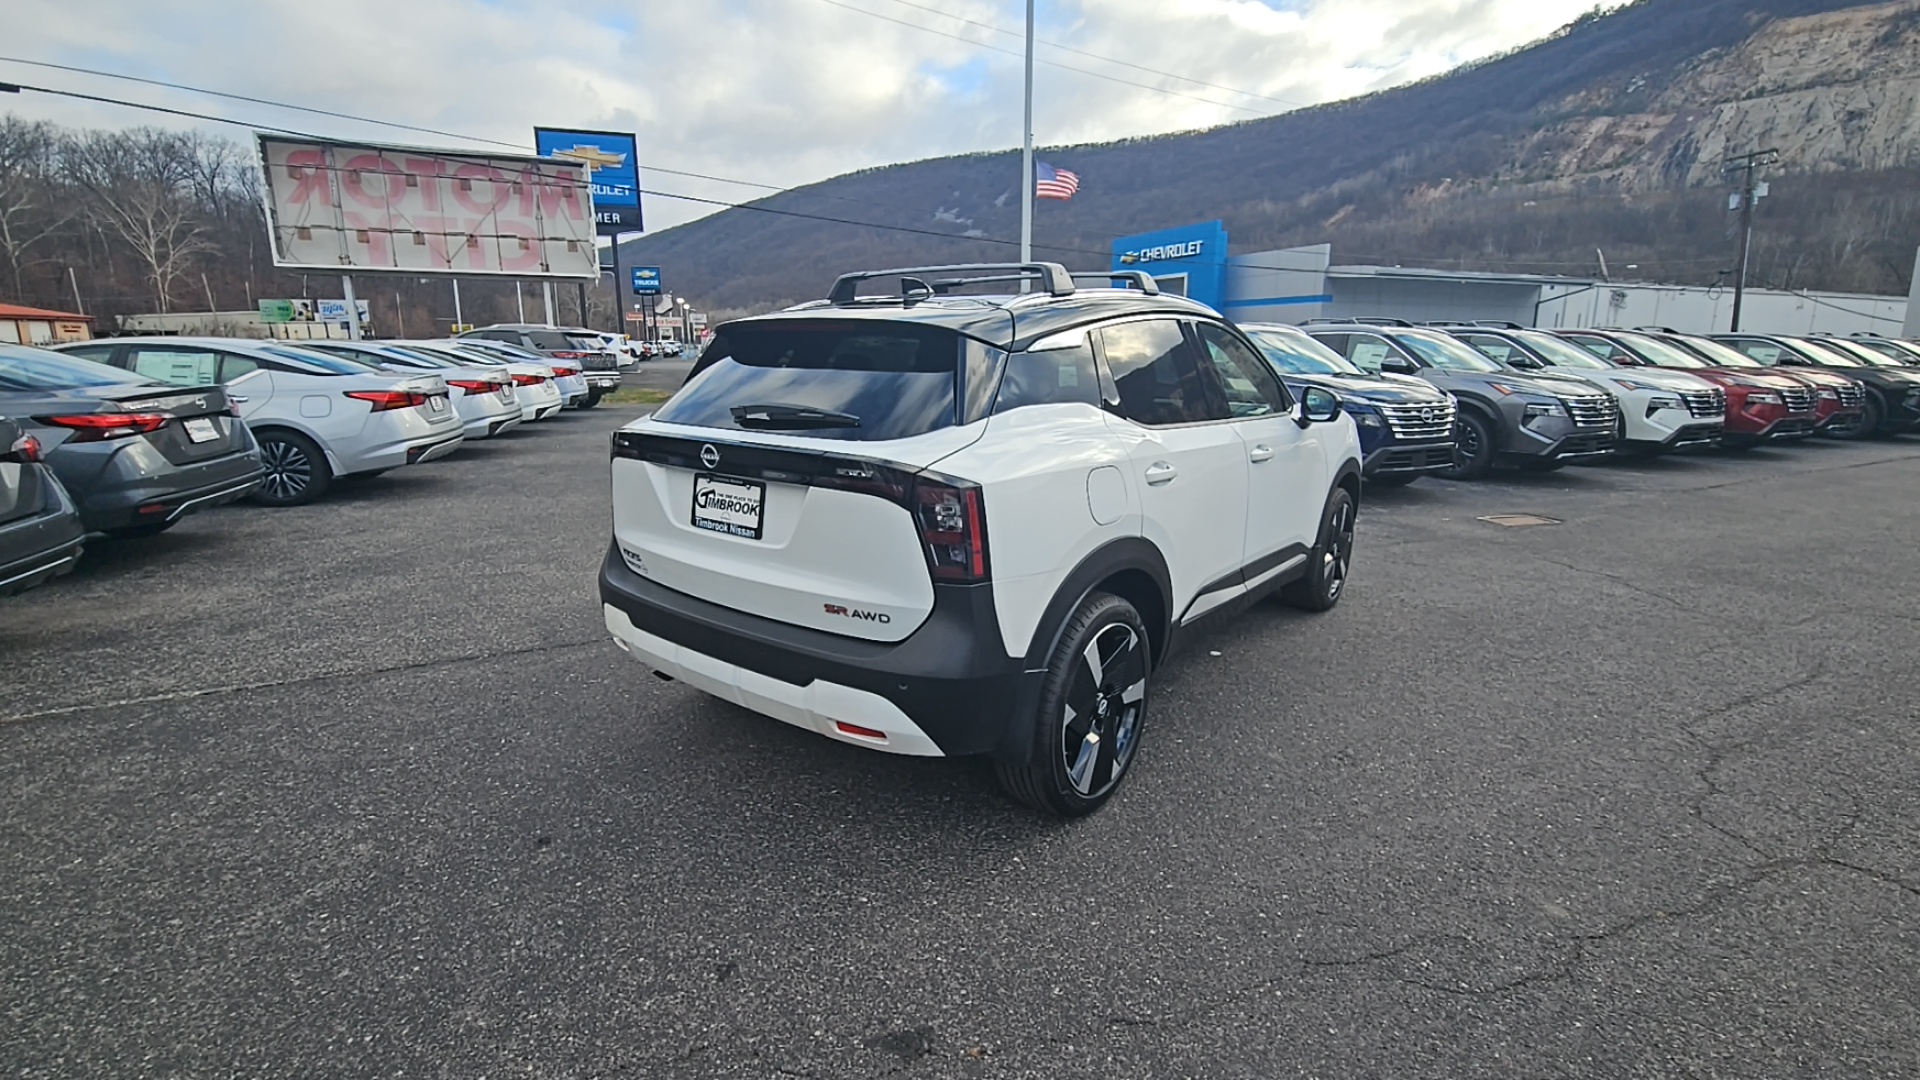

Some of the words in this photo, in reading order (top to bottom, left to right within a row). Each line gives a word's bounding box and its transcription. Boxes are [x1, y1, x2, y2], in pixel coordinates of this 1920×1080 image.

[1140, 240, 1203, 262] CHEVROLET
[696, 486, 760, 517] TIMBROOK
[695, 517, 729, 533] Timbrook
[729, 524, 756, 538] Nissan
[824, 603, 849, 617] SR
[851, 608, 891, 624] AWD
